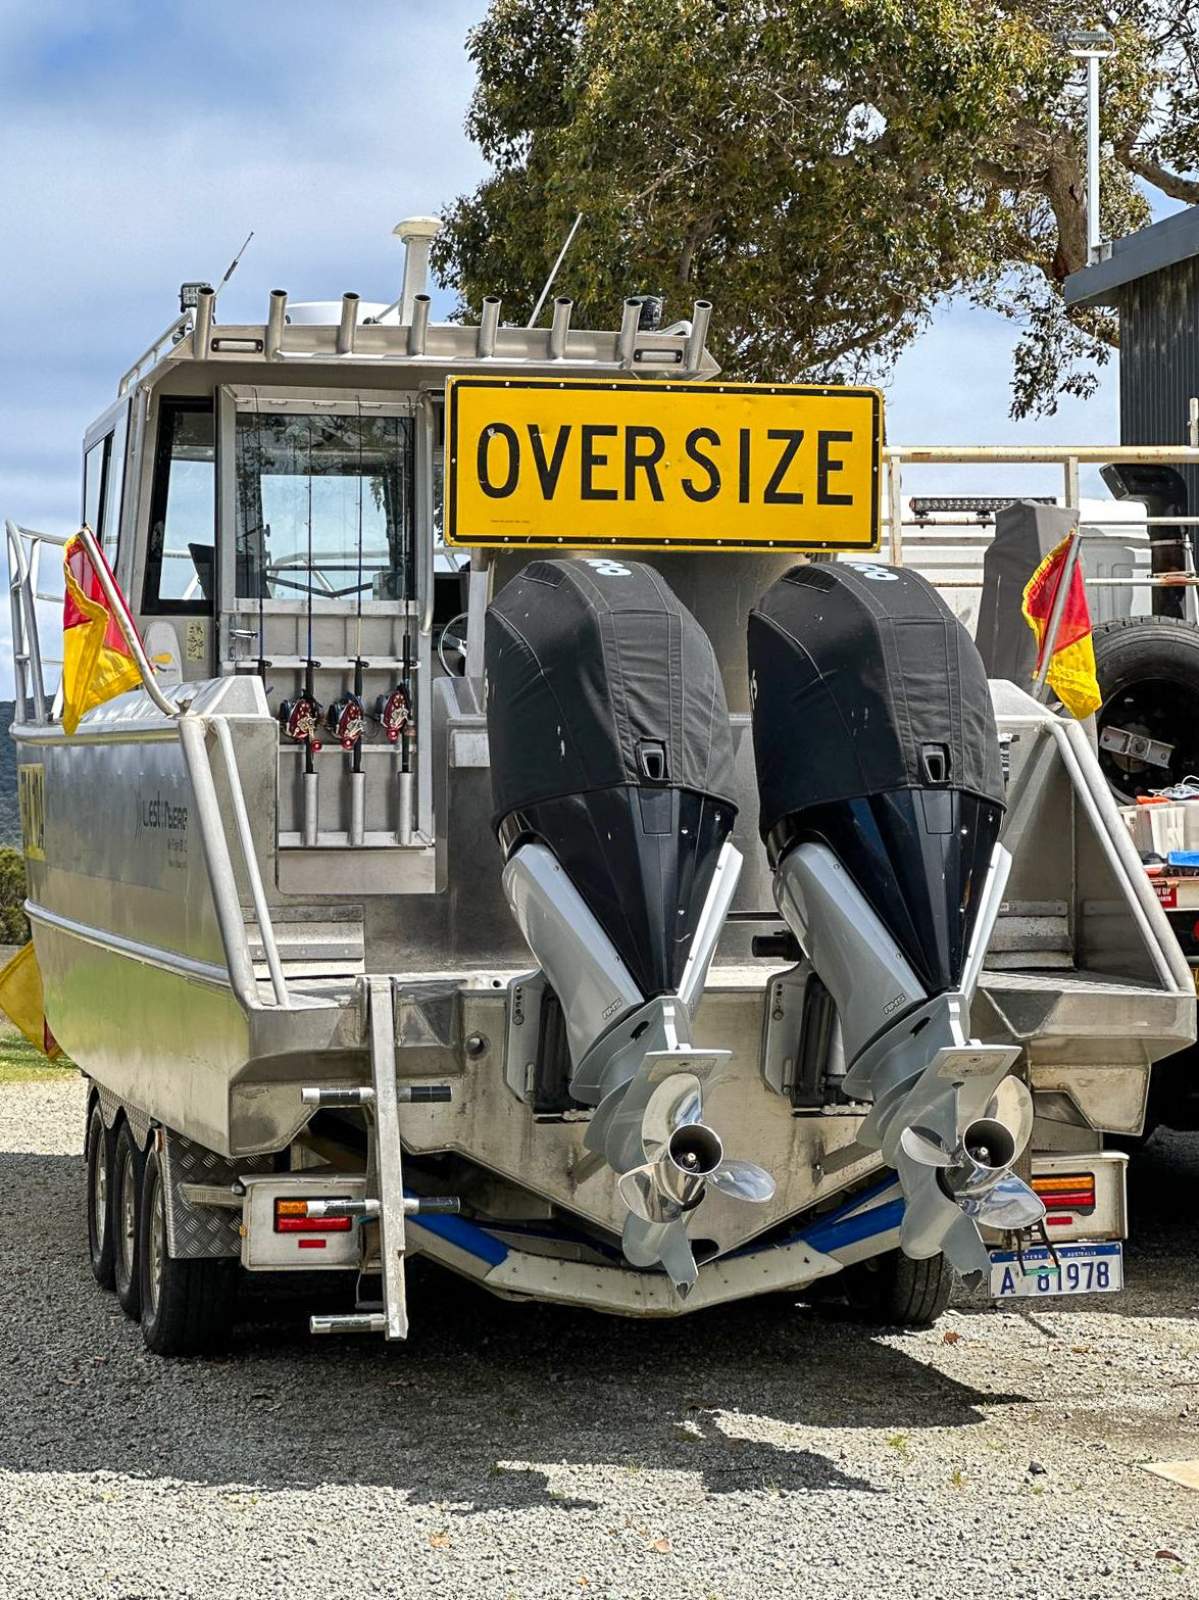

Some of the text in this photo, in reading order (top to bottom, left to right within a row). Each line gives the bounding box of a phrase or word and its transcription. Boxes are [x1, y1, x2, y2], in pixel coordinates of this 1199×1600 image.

[476, 422, 854, 506] OVERSIZE
[1000, 1261, 1109, 1295] A 81978
